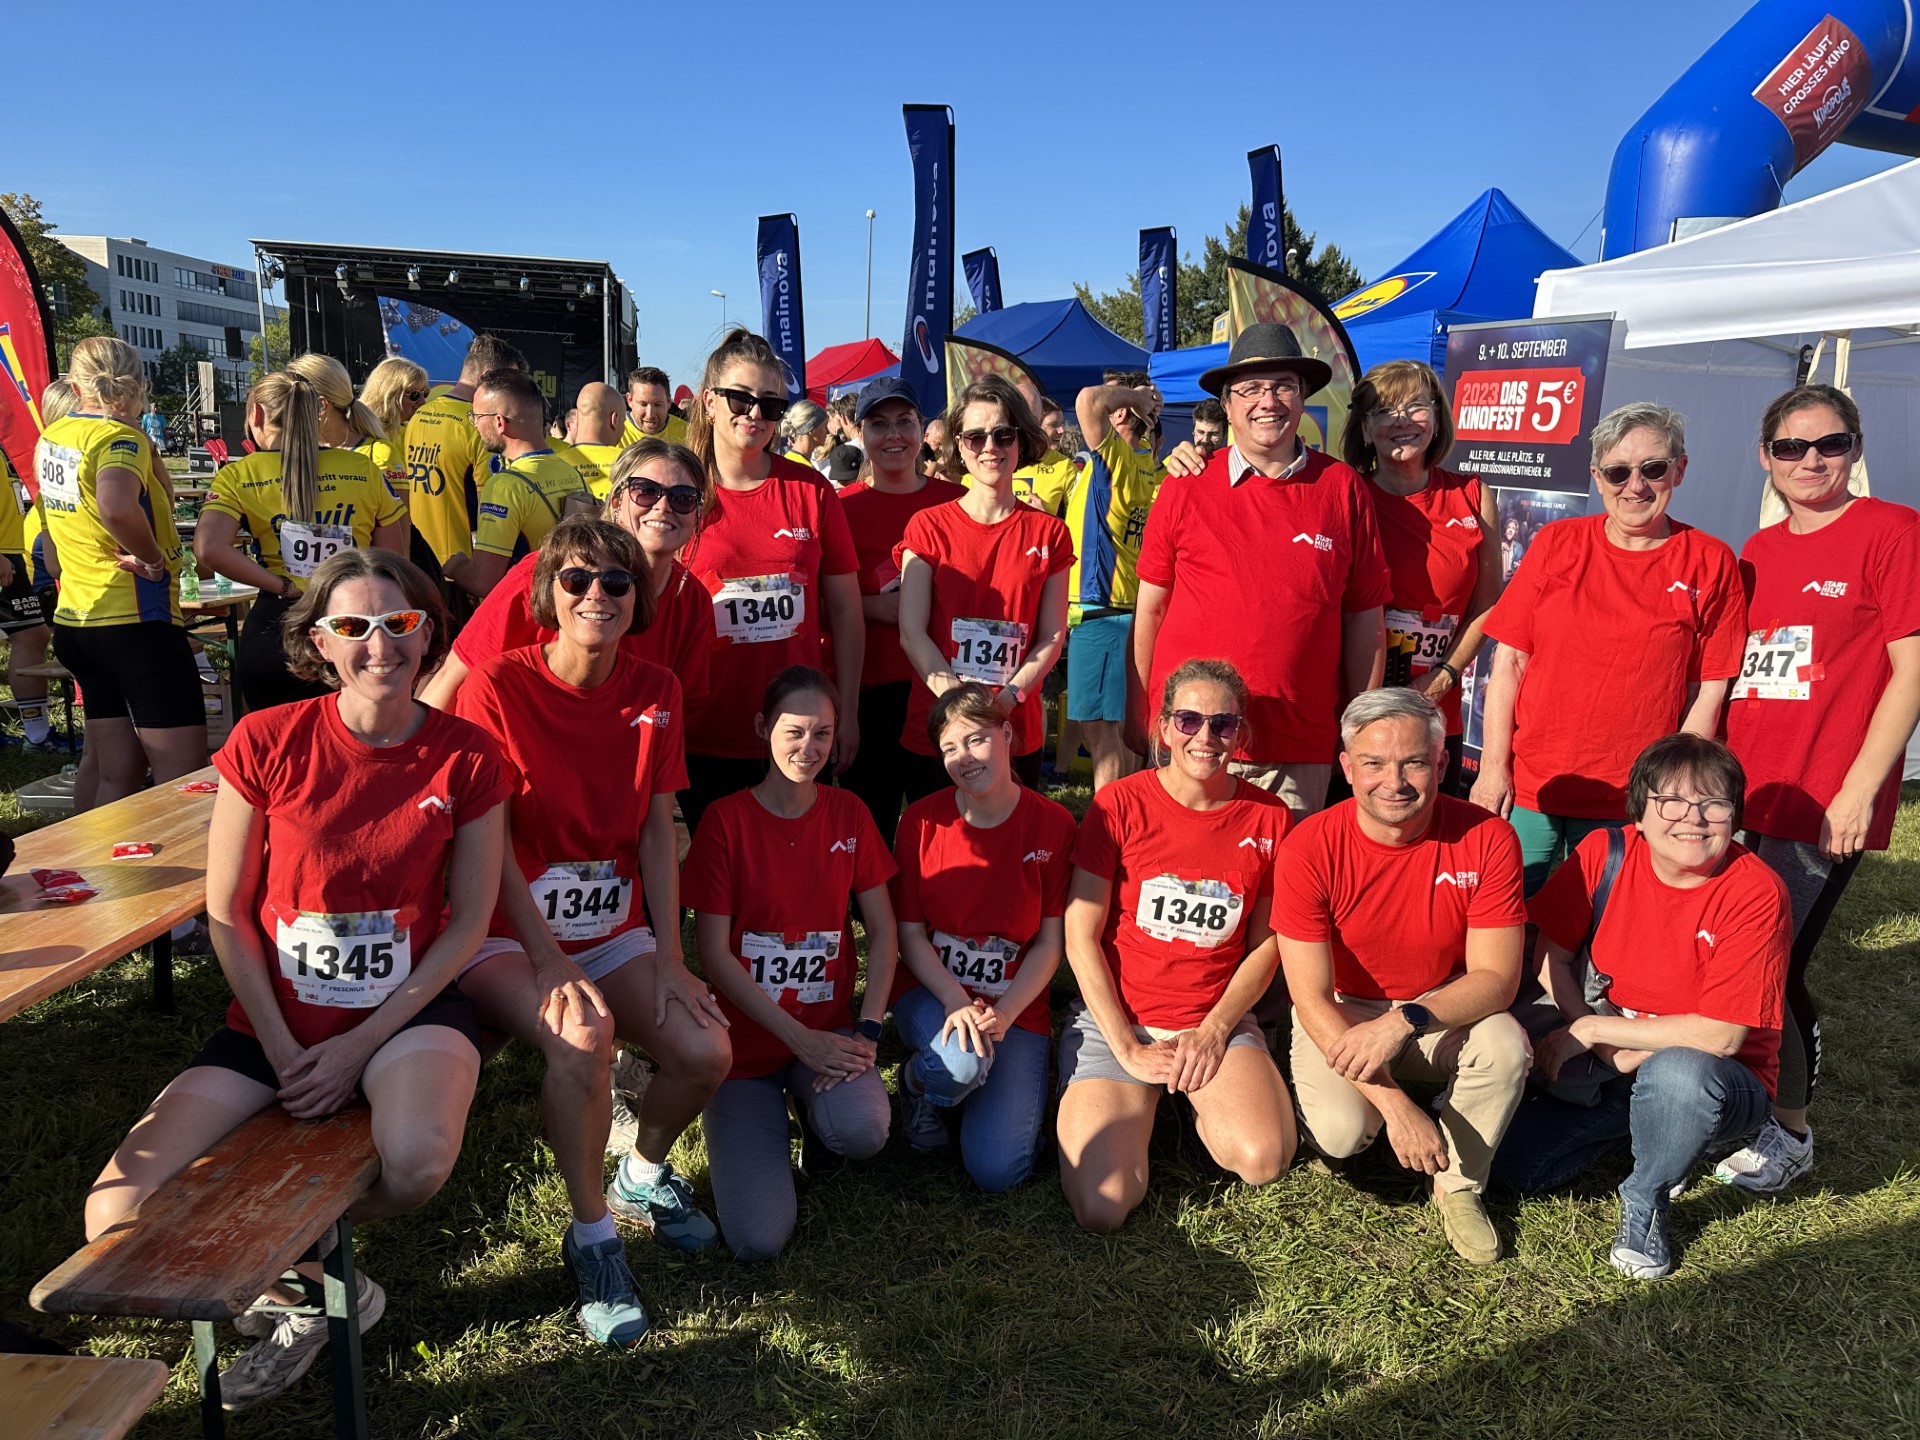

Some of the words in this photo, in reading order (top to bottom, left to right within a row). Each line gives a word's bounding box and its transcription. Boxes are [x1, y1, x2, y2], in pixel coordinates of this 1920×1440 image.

[1777, 67, 1806, 96] HIER
[1802, 34, 1832, 71] LÄUFT
[1783, 65, 1828, 114] GROSSES
[1825, 39, 1850, 69] KINO
[1812, 76, 1852, 129] KINOPOLIS
[776, 252, 793, 352] mainova
[1478, 343, 1487, 360] 9.
[1488, 346, 1496, 357] +
[1497, 343, 1509, 359] 10.
[1511, 339, 1568, 358] SEPTEMBER
[1461, 382, 1499, 405] 2023
[1500, 381, 1528, 405] DAS
[1458, 406, 1525, 431] KINOFEST
[1459, 461, 1471, 471] MENÜ
[1471, 462, 1479, 472] AN
[1469, 450, 1482, 460] ALLE
[1497, 451, 1510, 461] ALLE
[42, 459, 64, 486] 908
[339, 474, 368, 482] voraus
[407, 463, 445, 496] PRO
[293, 539, 338, 563] 913
[724, 594, 794, 625] 1340
[961, 638, 1018, 668] 1341
[1411, 631, 1449, 658] 339
[1743, 650, 1796, 678] 347
[1456, 871, 1478, 879] START
[543, 885, 620, 920] 1344
[1151, 895, 1228, 931] 1348
[292, 941, 393, 981] 1345
[751, 955, 826, 985] 1342
[940, 944, 1004, 984] 1343
